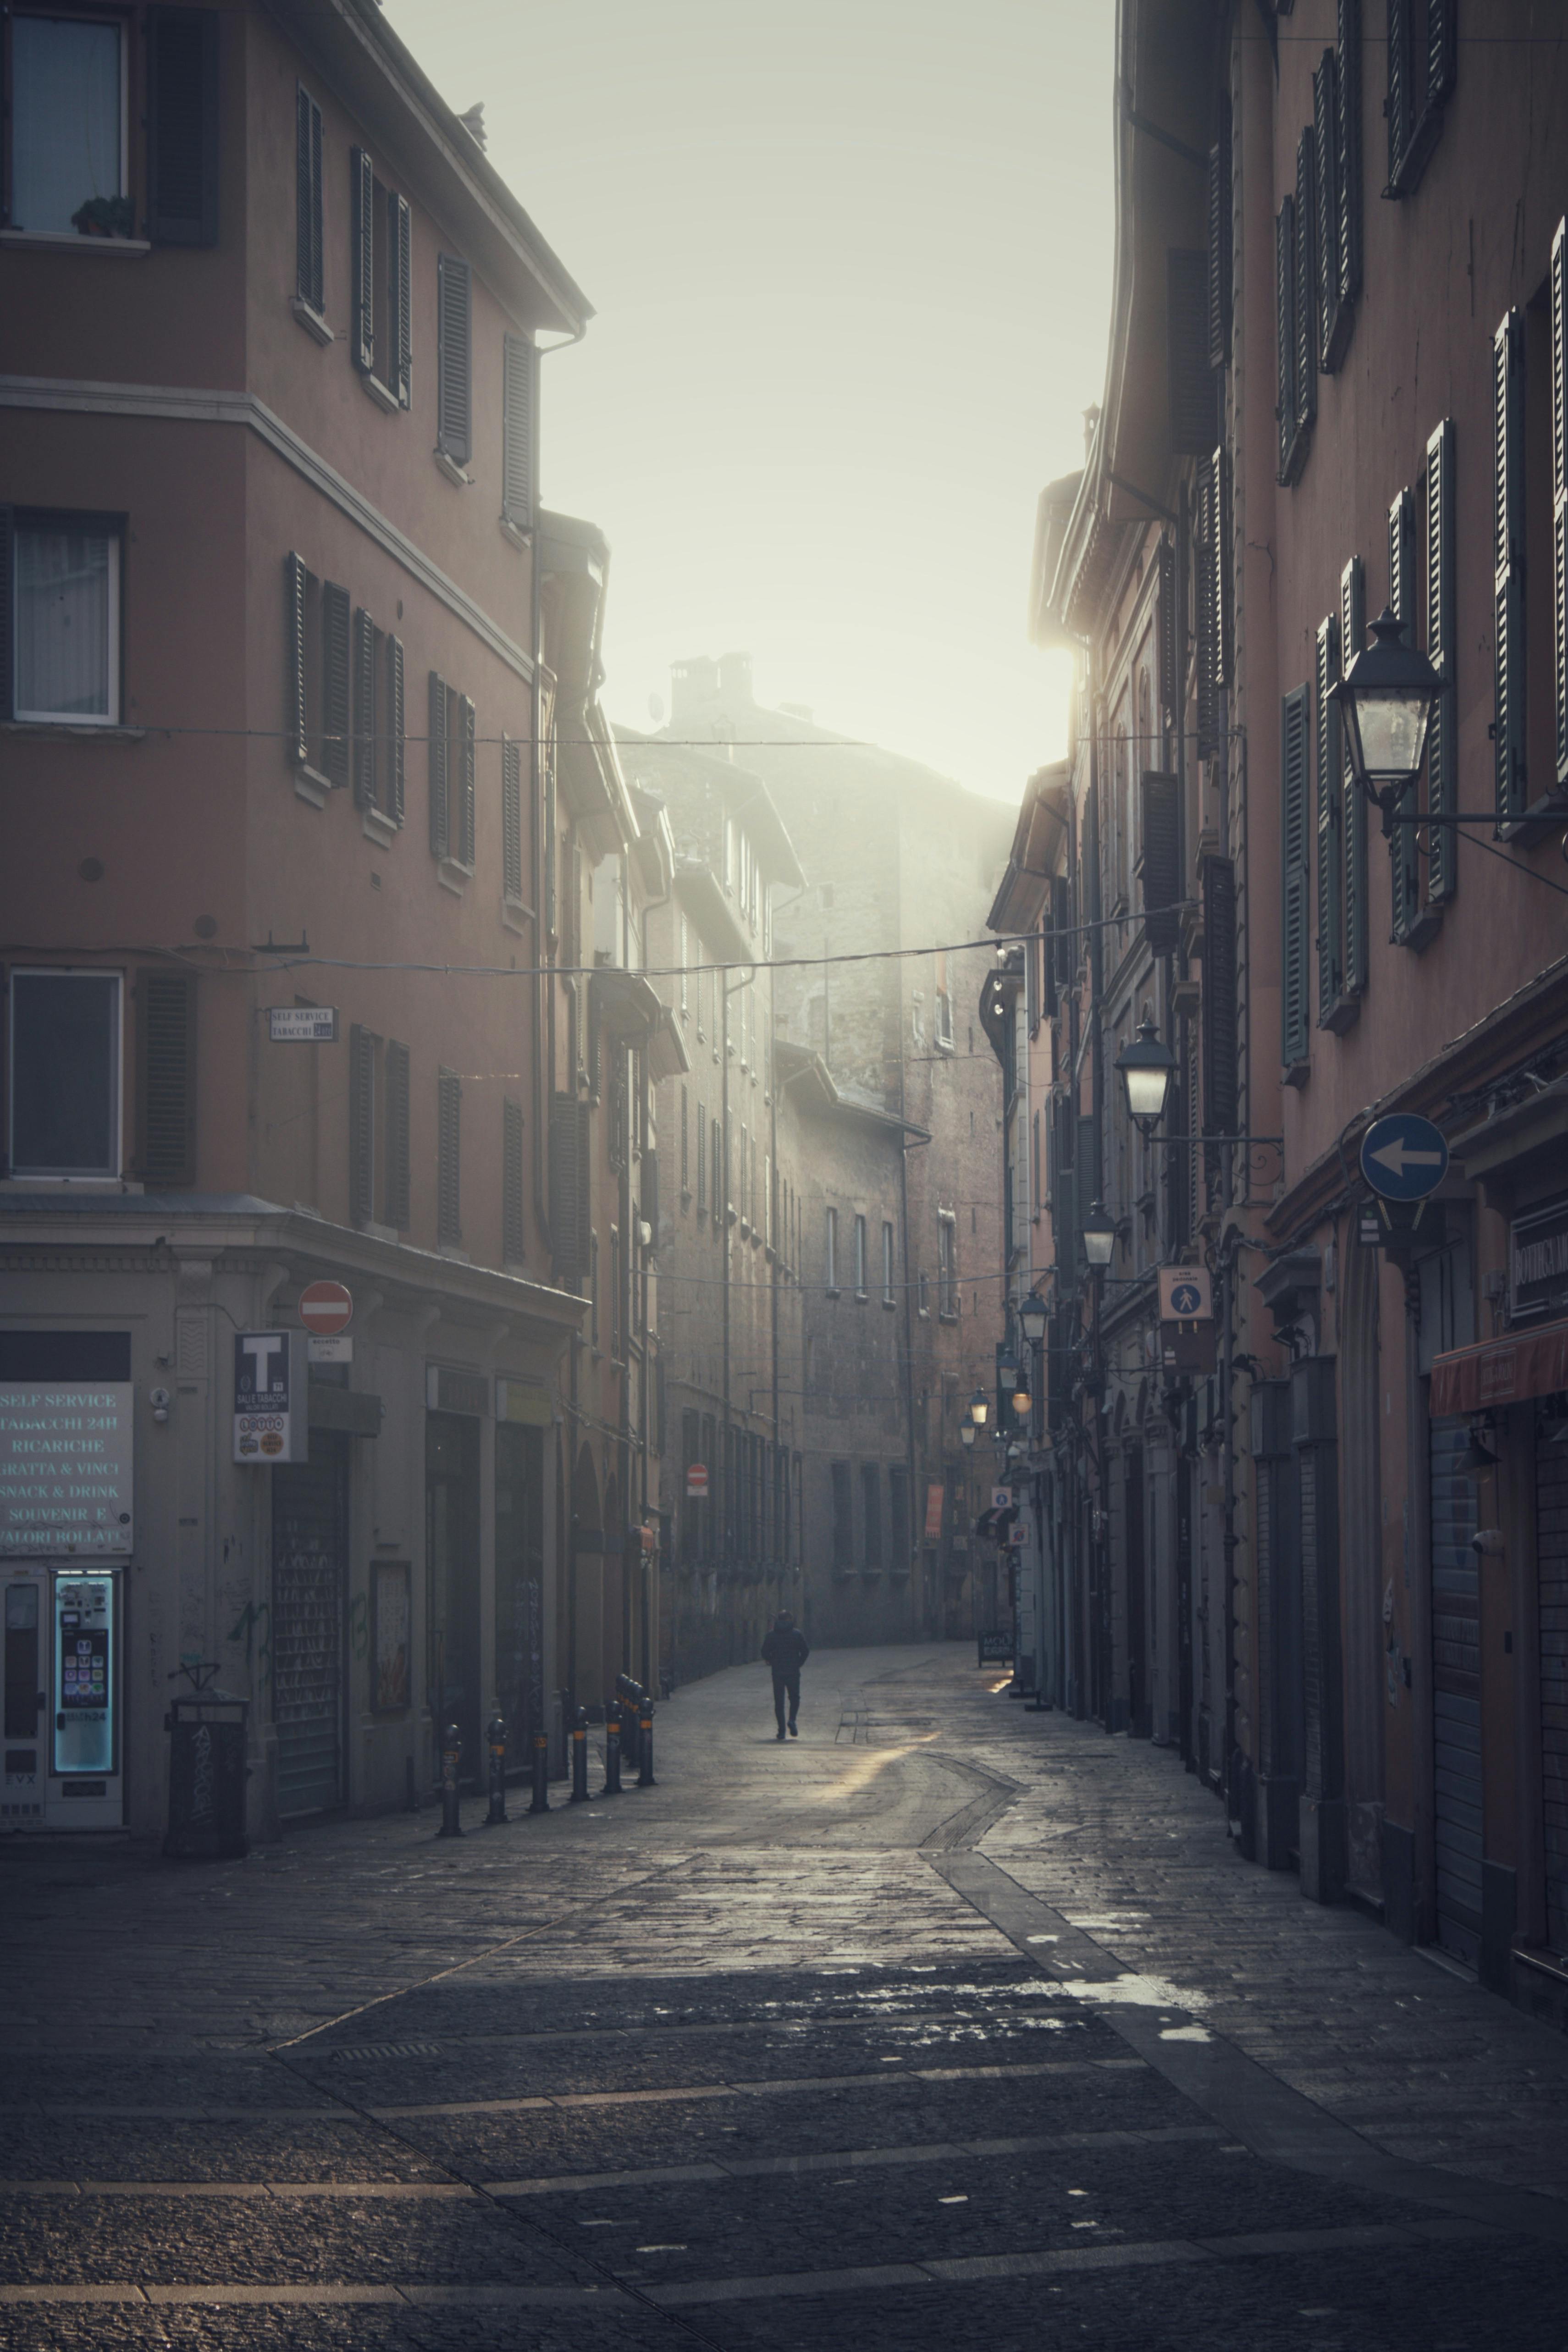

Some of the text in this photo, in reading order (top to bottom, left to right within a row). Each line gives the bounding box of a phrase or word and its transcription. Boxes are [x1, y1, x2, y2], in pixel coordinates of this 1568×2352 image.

[272, 1012, 329, 1021] SELF SERVICE
[273, 1027, 311, 1036] TABACCHI
[1515, 1238, 1555, 1286] BOTTEGA
[243, 1336, 282, 1392] T
[0, 1394, 116, 1408] SELF SERVICE
[237, 1393, 287, 1404] SALI E TABACCHI
[0, 1416, 117, 1430] TABACCHI 24H
[241, 1418, 283, 1431] LOTTO
[12, 1439, 105, 1452] RICARICHE
[60, 1462, 72, 1475] &
[77, 1462, 119, 1475] VINCI
[52, 1485, 64, 1498] &
[69, 1485, 119, 1498] DRINK
[9, 1507, 107, 1521] SOUVENIR E
[56, 1530, 121, 1543] BOLLATI
